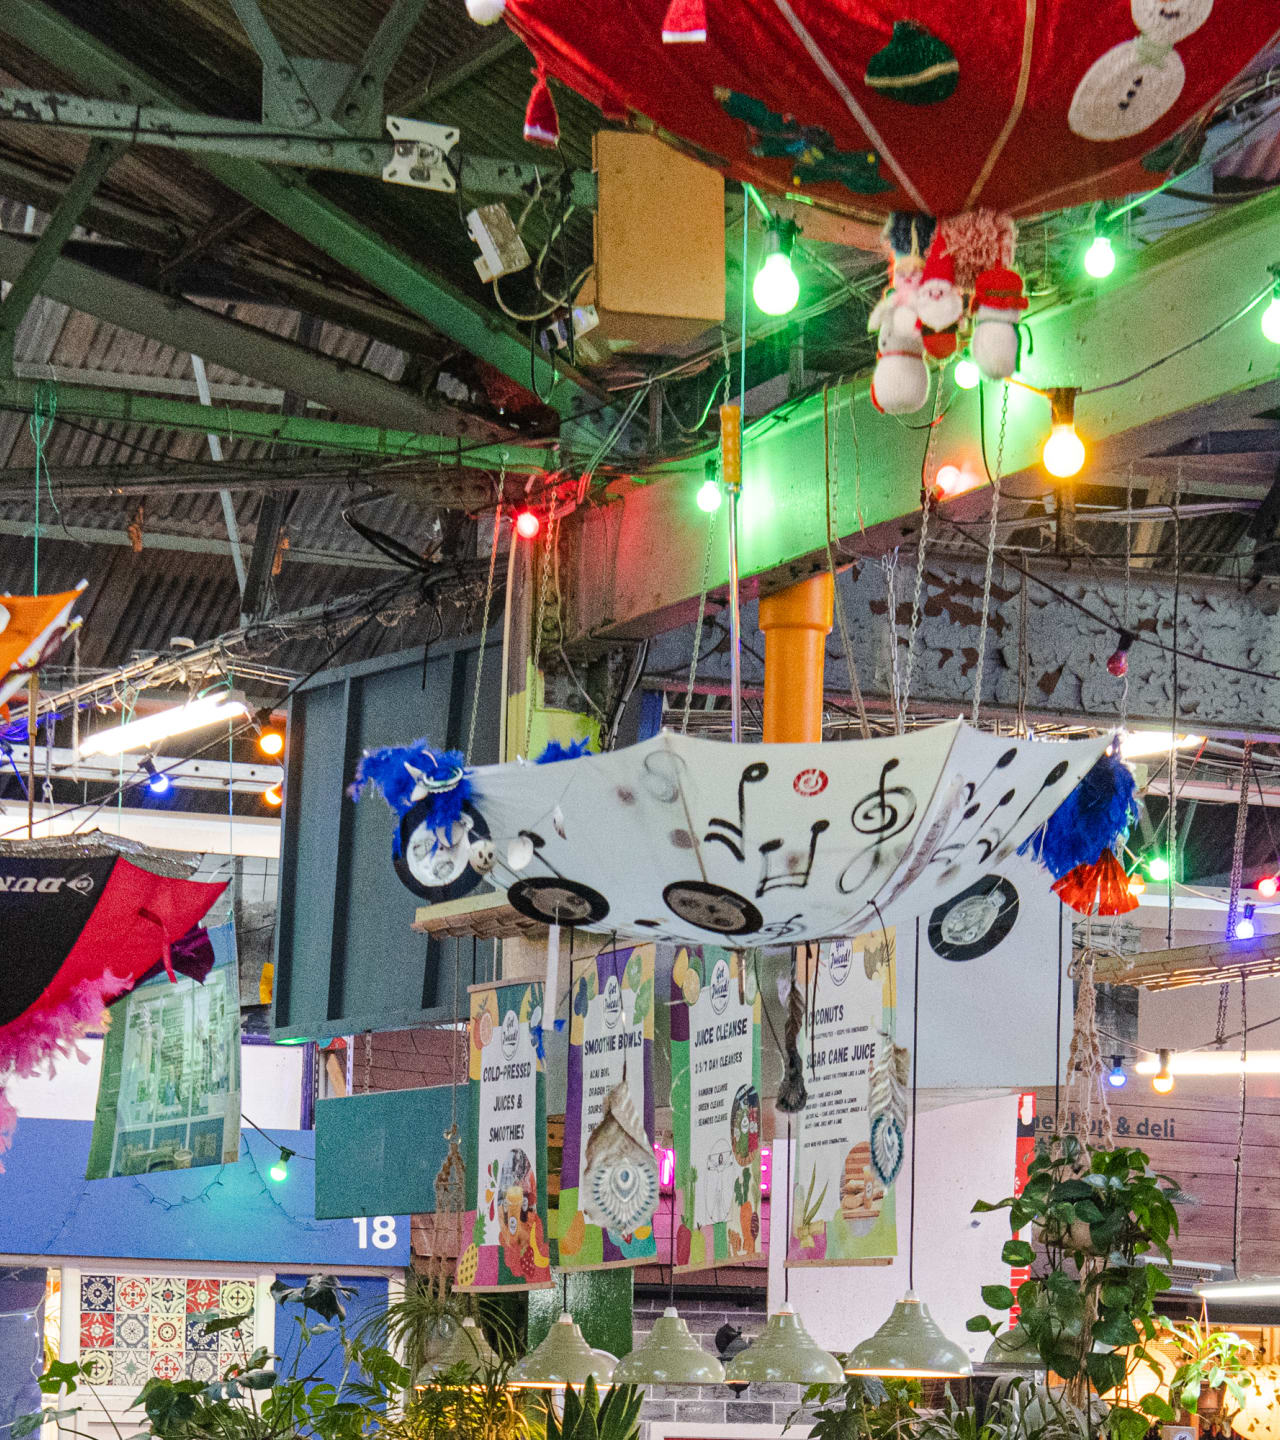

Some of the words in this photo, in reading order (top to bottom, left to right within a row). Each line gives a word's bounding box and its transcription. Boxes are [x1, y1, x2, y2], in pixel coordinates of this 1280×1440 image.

[584, 1034, 616, 1056] SMOOTHIE
[618, 1030, 642, 1050] BOWLS
[695, 1026, 714, 1048] JUICE
[716, 1018, 748, 1041] CLEANSE
[828, 1046, 849, 1065] CANE
[851, 1043, 876, 1061] JUICE
[483, 1061, 531, 1083] COLD-PRESSED
[493, 1095, 515, 1112] JUICES
[516, 1093, 523, 1110] &
[489, 1124, 525, 1143] SMOOTHIES
[1117, 1116, 1130, 1136] &
[1136, 1117, 1176, 1138] deli
[352, 1215, 398, 1250] 18
